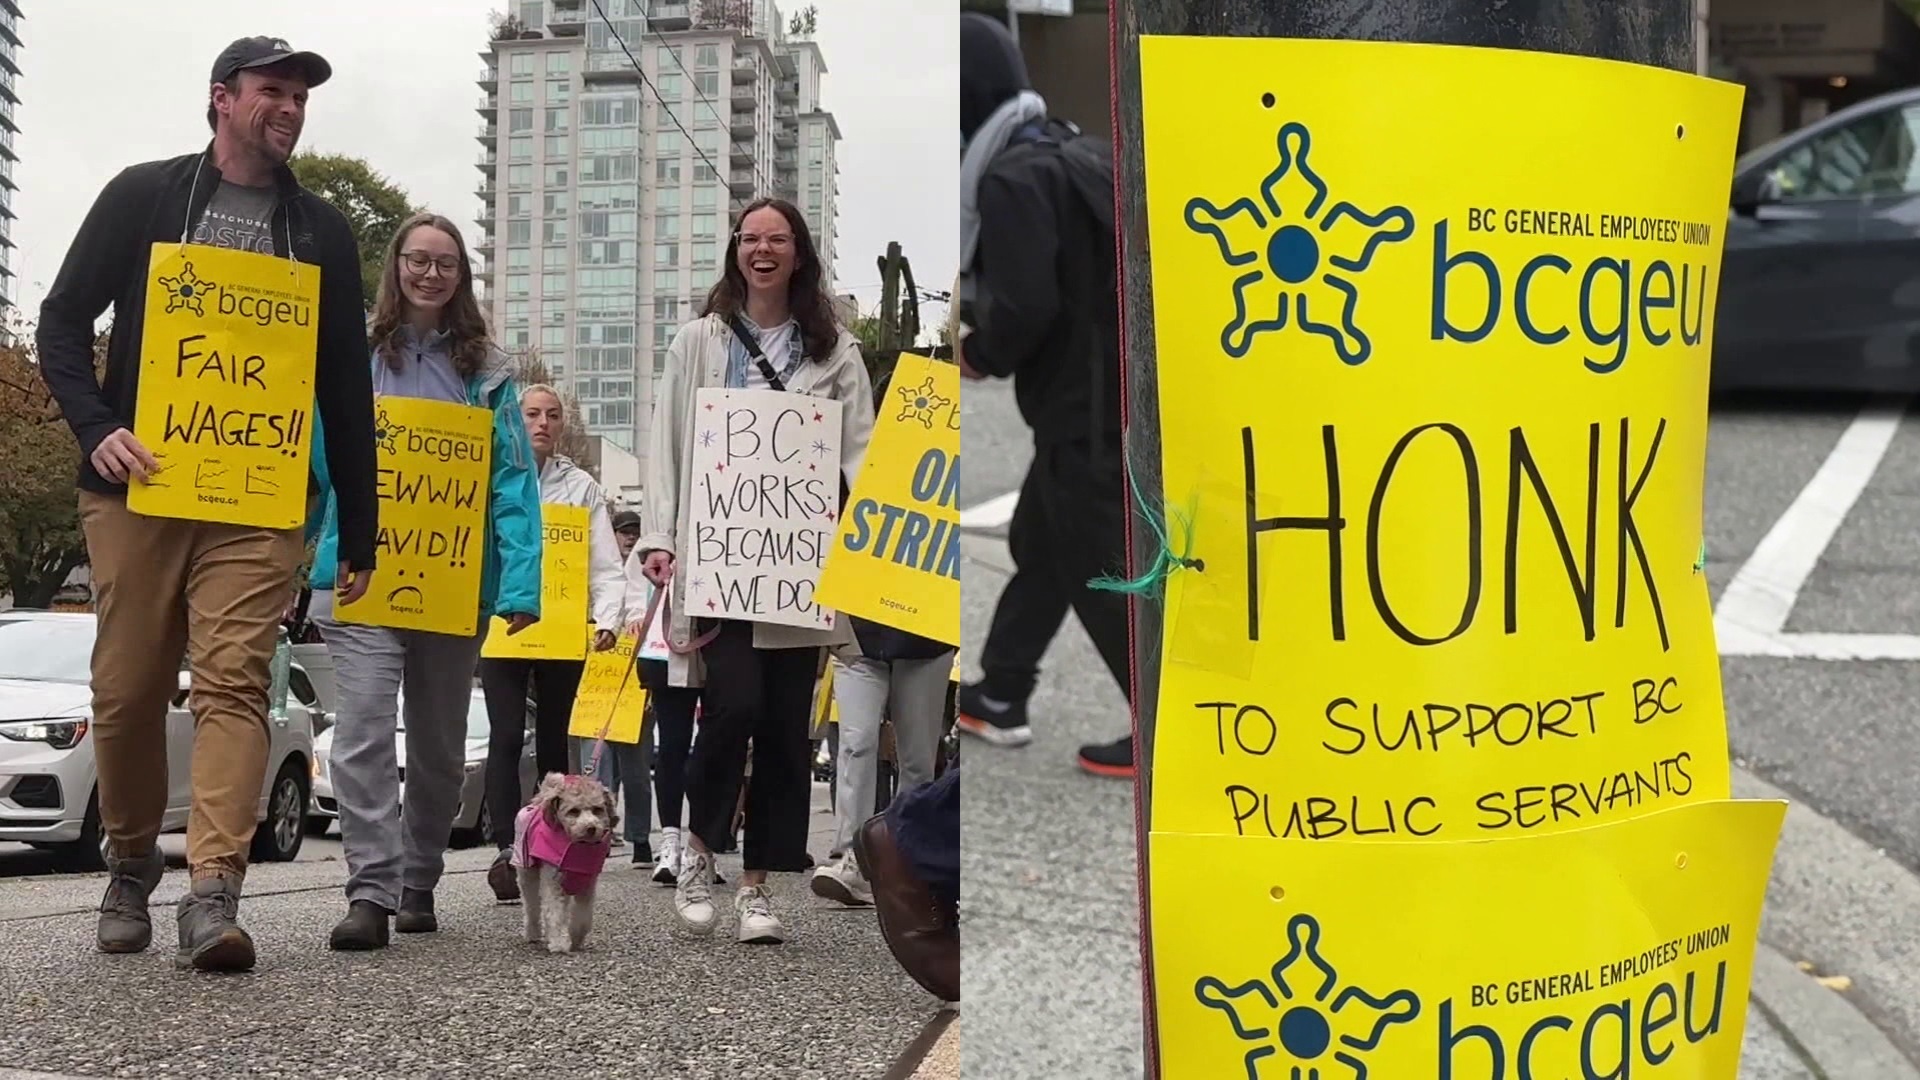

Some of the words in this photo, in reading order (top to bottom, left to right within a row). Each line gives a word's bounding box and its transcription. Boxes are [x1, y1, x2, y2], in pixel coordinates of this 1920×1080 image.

[1469, 207, 1496, 232] BC
[1505, 209, 1594, 237] GENERAL
[1600, 215, 1680, 243] EMPLOYEES'
[1684, 222, 1711, 246] UNION
[218, 286, 309, 327] bcgeu
[1431, 218, 1707, 374] bcgeu
[177, 335, 266, 390] FAIR
[164, 401, 305, 458] WAGES!!
[408, 429, 484, 462] bcgeu
[198, 494, 239, 506] bcgeu.ca
[705, 472, 827, 520] WORKS
[697, 521, 832, 568] BECAUSE
[1241, 417, 1670, 653] HONK
[715, 572, 768, 614] WE
[879, 597, 919, 615] bcgeu.ca
[1195, 702, 1277, 755] TO
[1322, 691, 1605, 755] SUPPORT
[1632, 677, 1683, 725] BC
[1225, 785, 1442, 839] PUBLIC
[1476, 752, 1692, 830] SERVANTS
[1471, 985, 1499, 1007] BC
[1506, 970, 1594, 1004] GENERAL
[1600, 938, 1683, 988] EMPLOYEES'
[1686, 923, 1730, 955] UNION
[1437, 960, 1727, 1080] bcgeu
